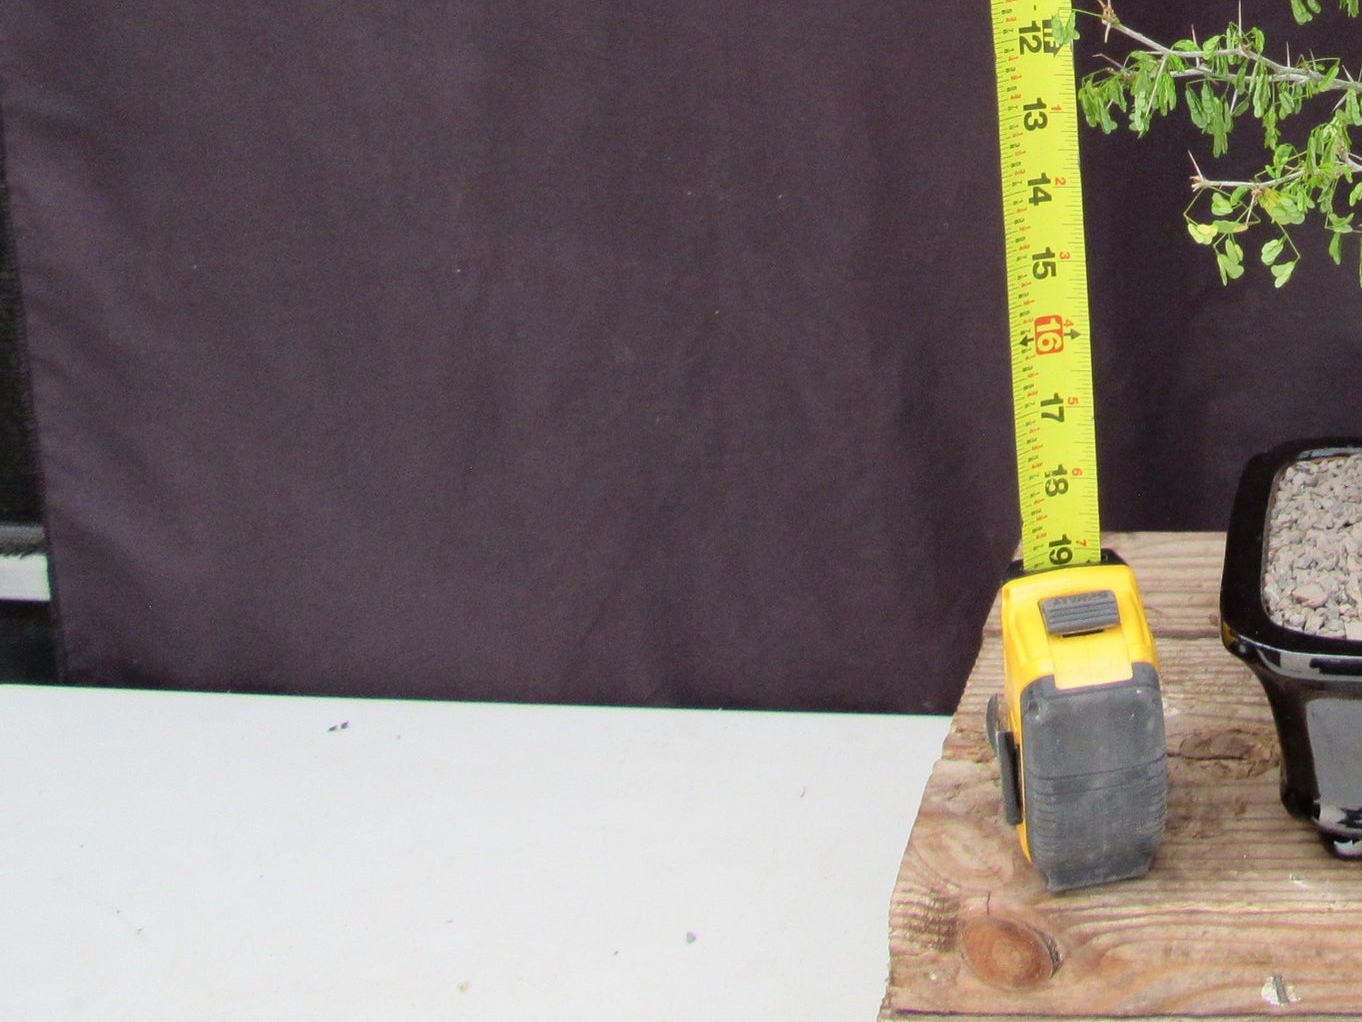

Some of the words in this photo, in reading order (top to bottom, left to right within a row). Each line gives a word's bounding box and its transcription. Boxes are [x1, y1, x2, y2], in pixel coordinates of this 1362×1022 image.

[1018, 20, 1042, 55] 12
[1023, 97, 1048, 131] 13
[1027, 172, 1053, 206] 14
[1055, 177, 1067, 186] 2
[1032, 246, 1057, 280] 15
[1059, 251, 1071, 260] 3
[1036, 316, 1062, 353] 16
[1063, 318, 1075, 328] 4
[1040, 392, 1065, 423] 17
[1067, 396, 1079, 406] 5
[1044, 464, 1069, 497] 18
[1071, 467, 1083, 477] 6
[1048, 534, 1073, 565] 19
